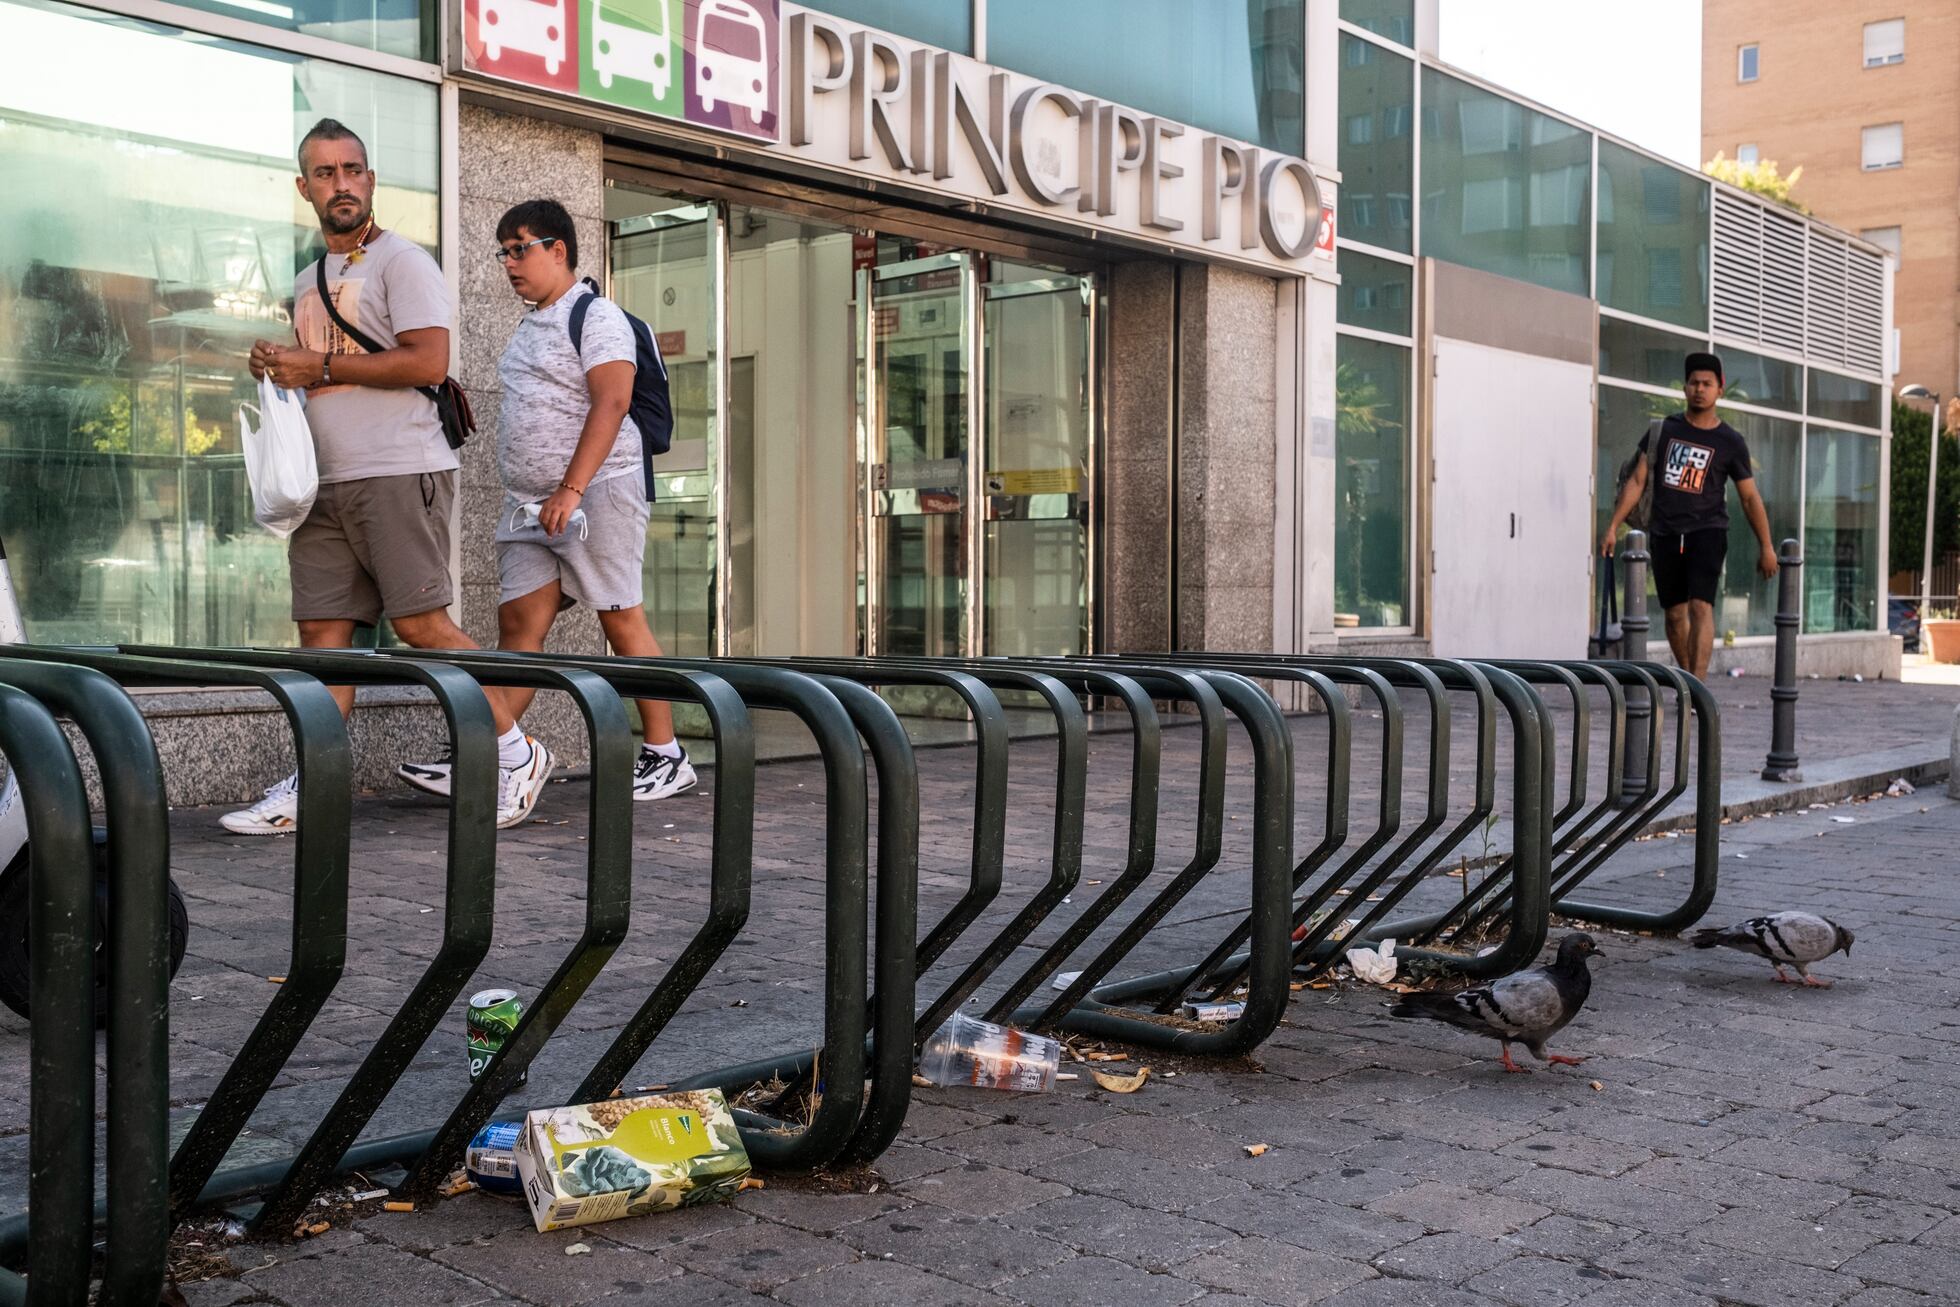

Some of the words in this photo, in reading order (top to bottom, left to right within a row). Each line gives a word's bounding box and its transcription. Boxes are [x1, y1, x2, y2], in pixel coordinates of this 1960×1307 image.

[790, 12, 1184, 231] PRINCIPE
[1202, 136, 1321, 259] PIO
[469, 1008, 507, 1036] ORIGIN
[660, 1118, 676, 1145] Blanco
